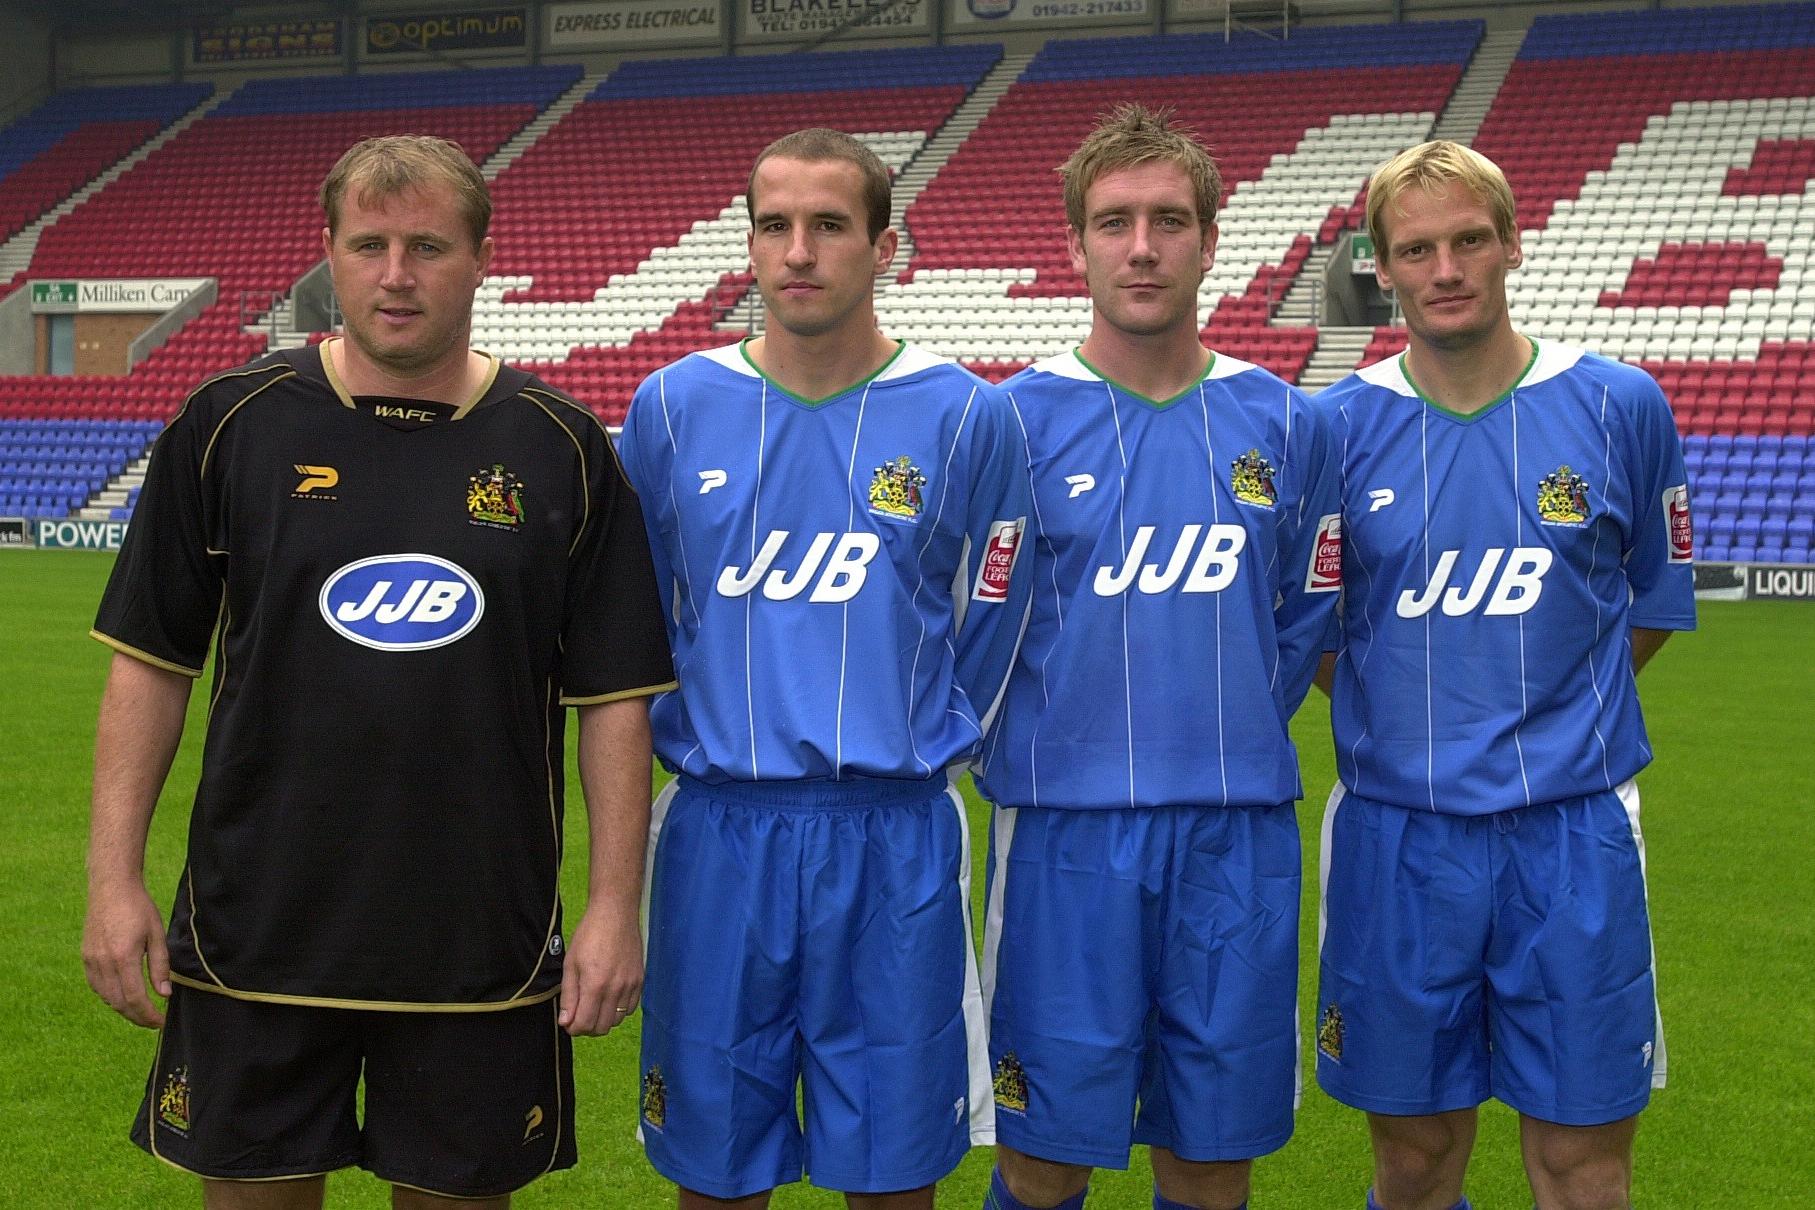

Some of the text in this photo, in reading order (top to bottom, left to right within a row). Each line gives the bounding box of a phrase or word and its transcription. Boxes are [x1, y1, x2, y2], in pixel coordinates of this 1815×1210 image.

[403, 15, 523, 48] optimum
[556, 7, 715, 32] EXPRESS ELECTRICAL
[83, 284, 146, 303] Milliken
[375, 404, 437, 422] WAFC
[40, 521, 130, 548] POWE
[716, 529, 881, 603] JJB
[1093, 523, 1248, 597] JJB
[1396, 547, 1553, 619] JJB
[1756, 570, 1815, 597] LIQUI
[336, 579, 468, 624] JJB
